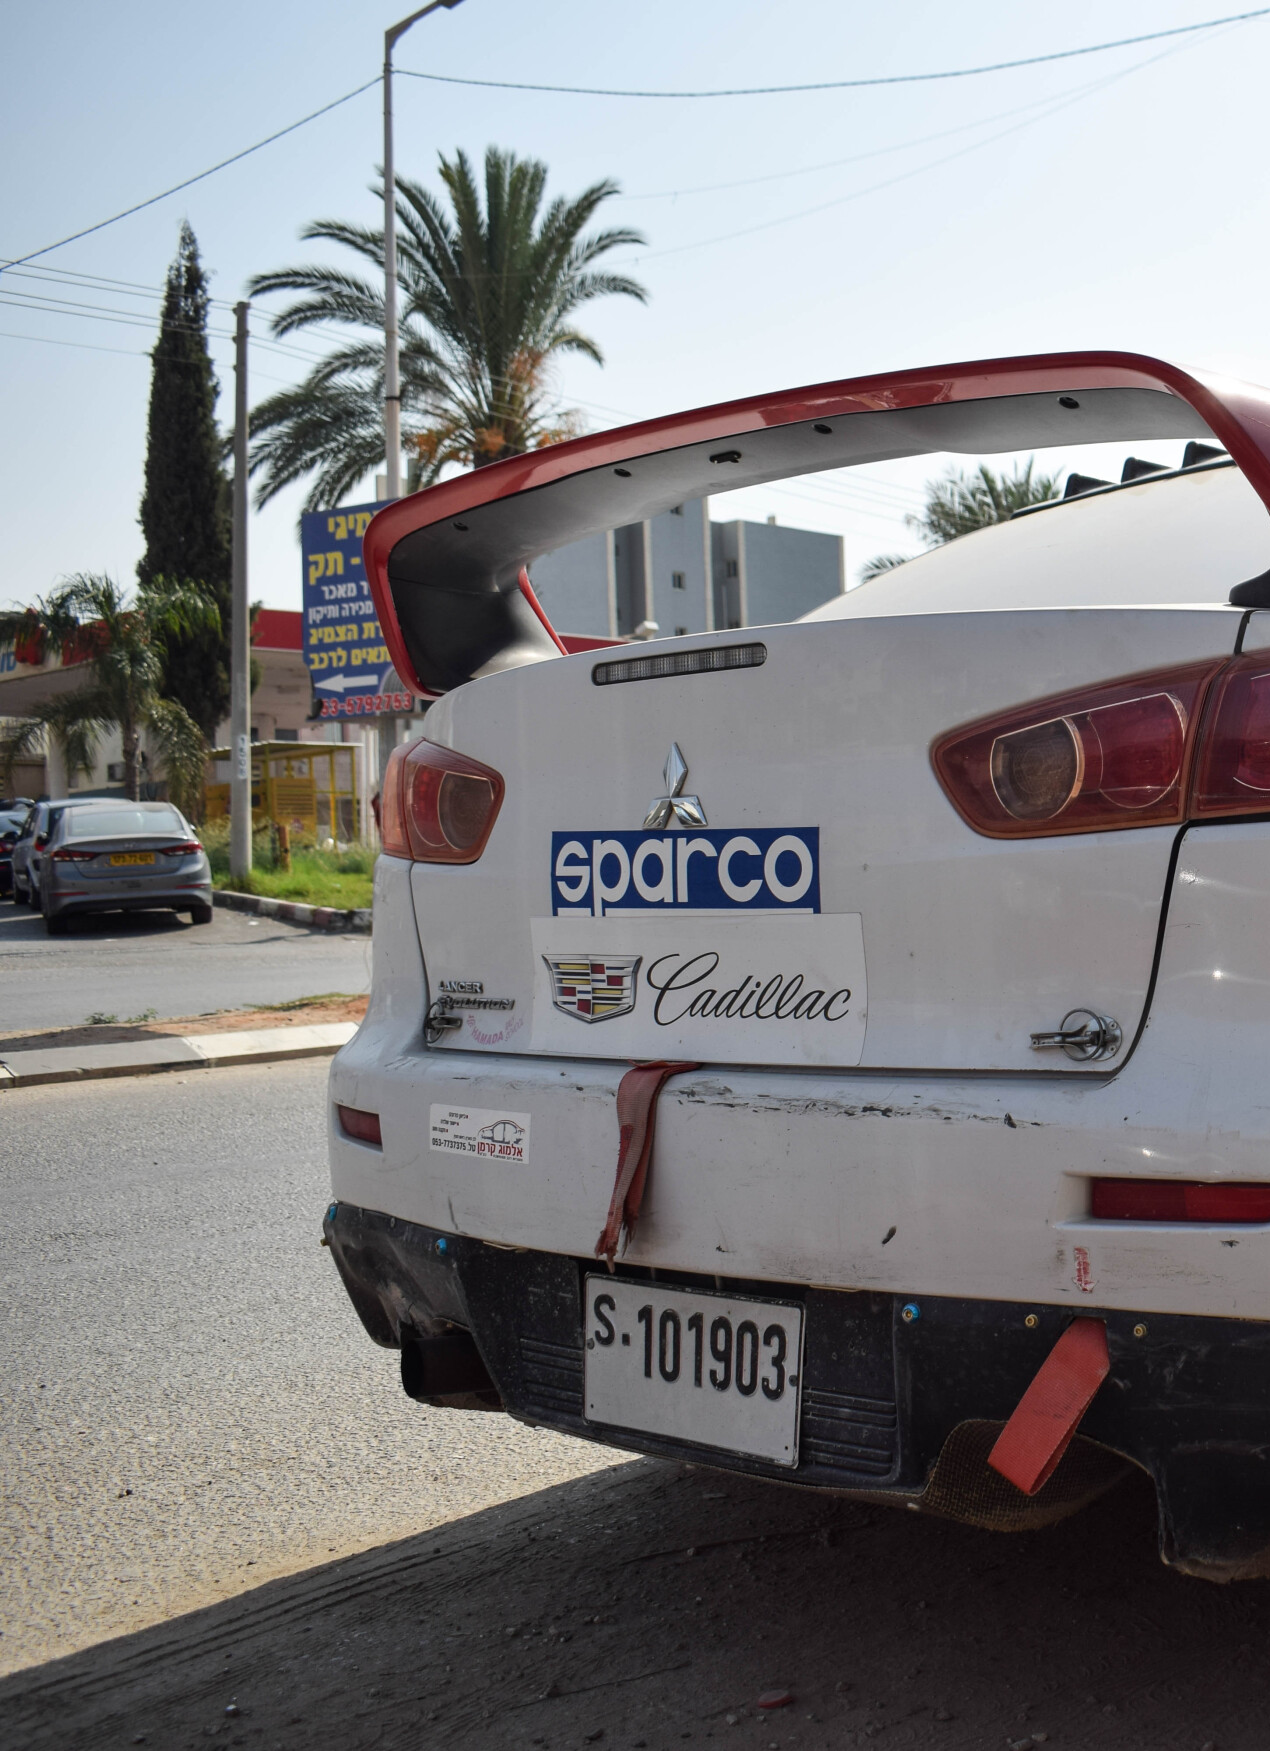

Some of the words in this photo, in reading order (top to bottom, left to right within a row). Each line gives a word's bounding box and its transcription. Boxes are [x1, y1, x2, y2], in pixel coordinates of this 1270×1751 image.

[328, 510, 379, 540] מיגי
[308, 604, 339, 624] ותיקון
[341, 600, 374, 617] מכירה
[309, 624, 358, 645] הצמיג
[309, 647, 347, 670] לרכב
[320, 692, 412, 717] 53-5792753
[555, 834, 814, 916] sparco
[439, 981, 483, 993] LANCER
[647, 952, 852, 1026] Cadillac
[593, 1293, 787, 1401] S.101903
